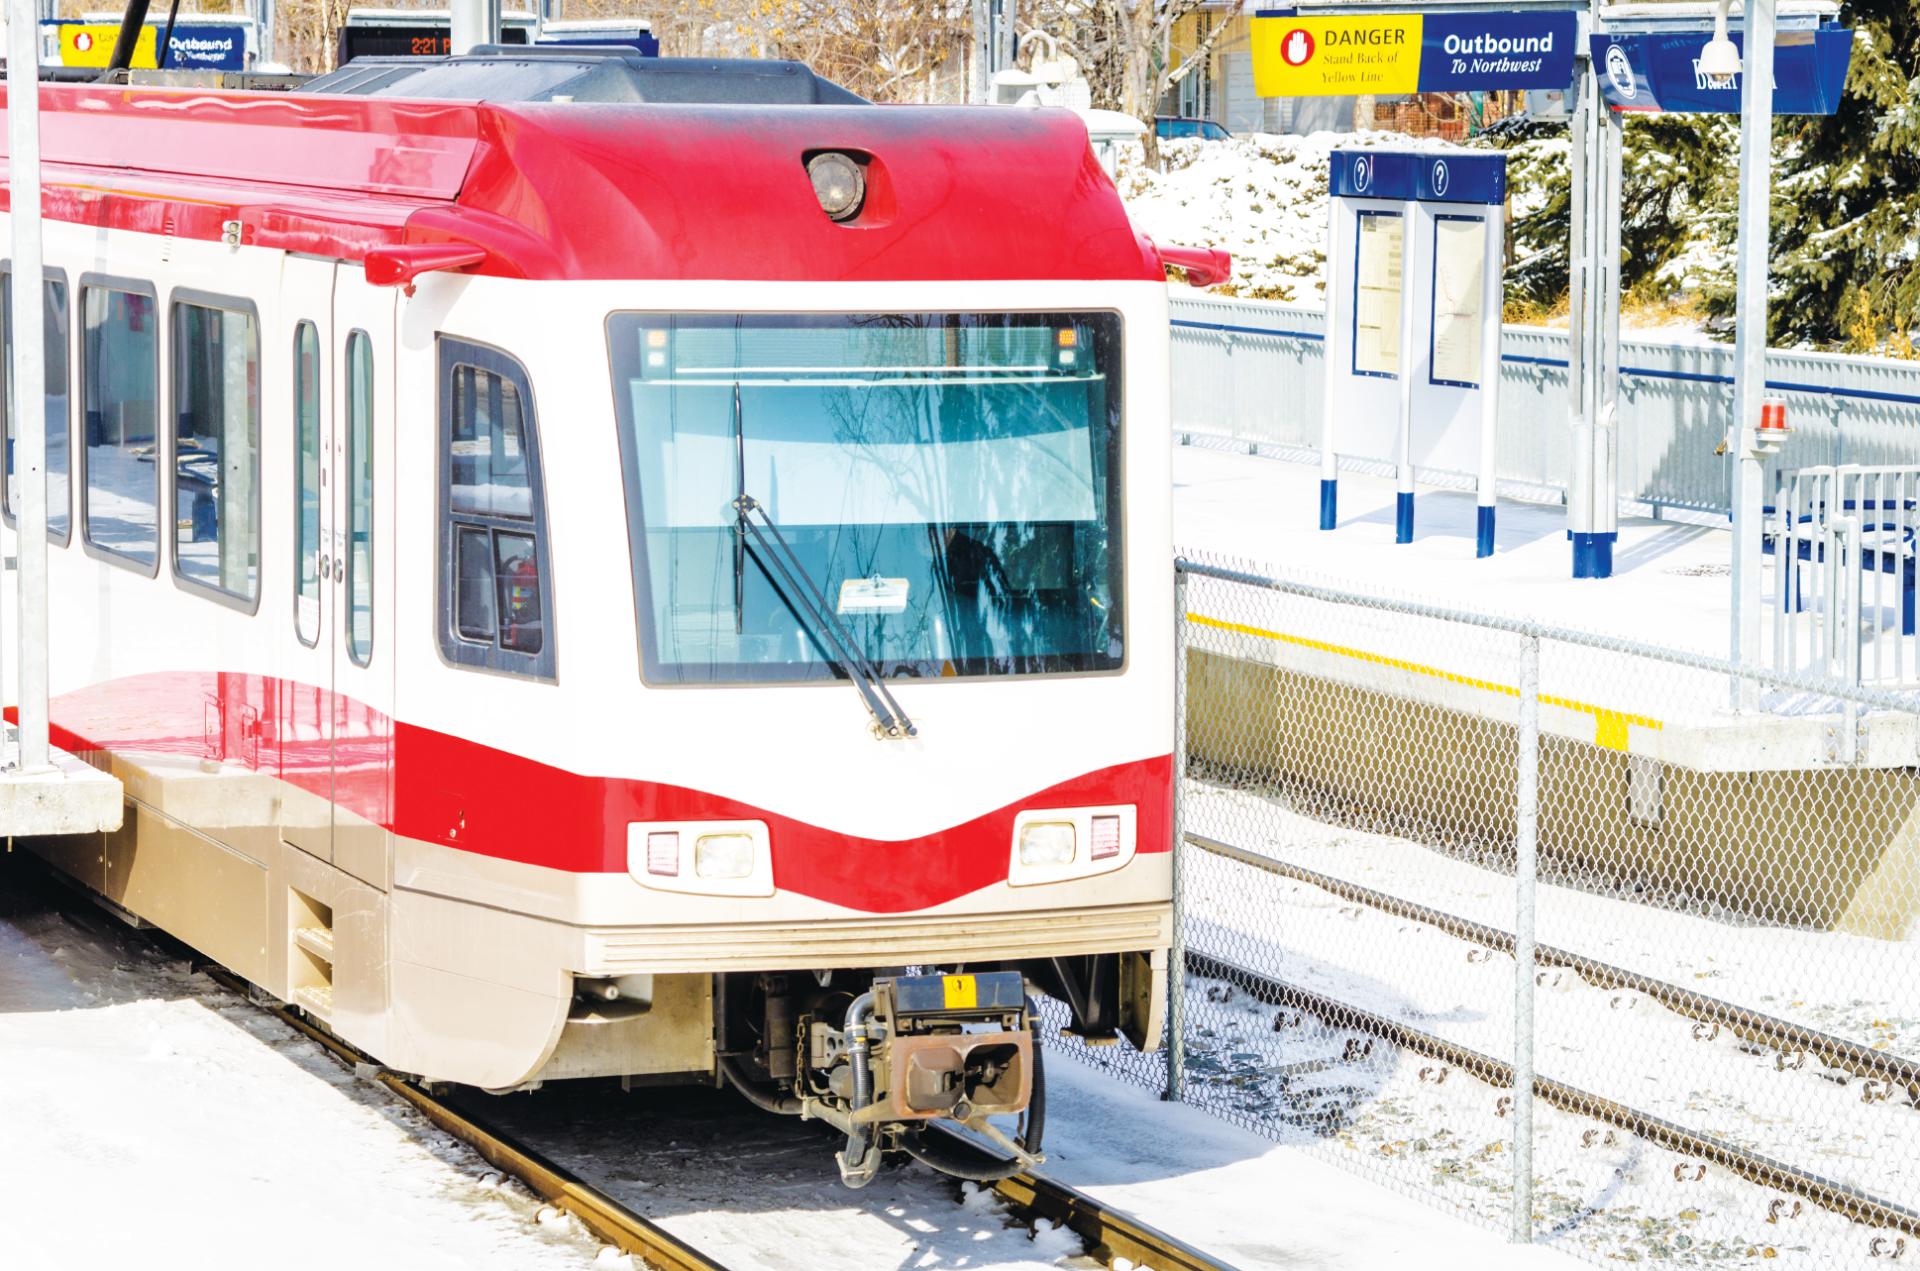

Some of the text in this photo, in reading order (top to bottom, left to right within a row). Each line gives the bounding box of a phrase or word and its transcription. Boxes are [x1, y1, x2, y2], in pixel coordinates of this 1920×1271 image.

[411, 37, 437, 54] 2:21
[1325, 29, 1406, 46] DANGER
[1444, 32, 1553, 54] Outbound
[1323, 50, 1399, 65] Stand Back of
[1451, 57, 1542, 74] To Northwest
[1322, 71, 1384, 83] Yellow Line
